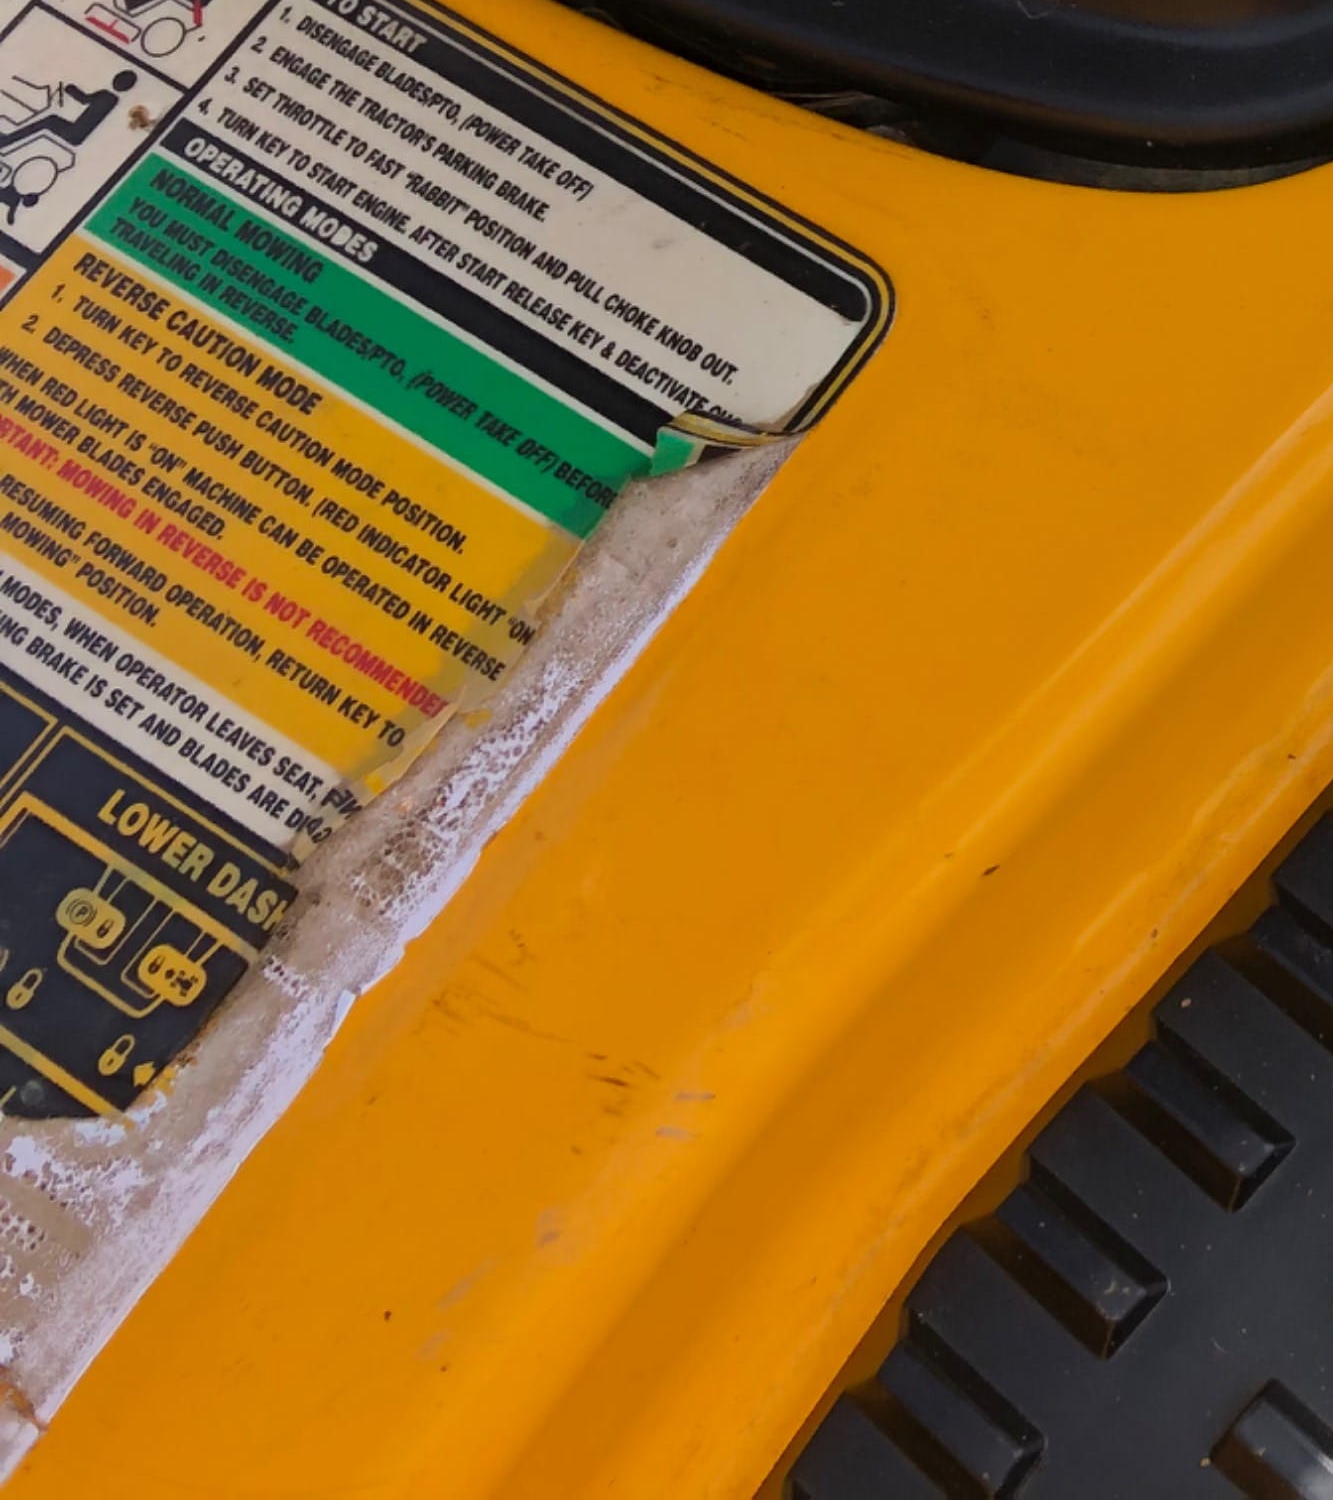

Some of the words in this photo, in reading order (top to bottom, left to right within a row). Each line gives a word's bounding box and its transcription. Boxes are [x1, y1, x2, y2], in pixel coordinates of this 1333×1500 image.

[280, 7, 292, 23] 1.
[296, 16, 379, 71] DISENGAGE
[458, 115, 521, 155] (POWER
[518, 146, 560, 179] TAKE
[556, 171, 594, 201] OFF)
[357, 6, 426, 52] START
[185, 138, 302, 217] OPERATING
[300, 206, 377, 261] MODES
[251, 36, 267, 53] 2.
[270, 46, 331, 89] ENGAGE
[329, 80, 361, 107] THE
[358, 97, 437, 152] TRACTOR'S
[432, 143, 498, 189] PARKING
[495, 180, 549, 222] BRAKE.
[111, 218, 200, 281] TRAVELING
[198, 273, 223, 294] IN
[219, 286, 297, 343] REVERSE.
[150, 169, 235, 231] NORMAL
[235, 220, 323, 283] MOWING
[198, 99, 212, 115] 4.
[218, 107, 260, 140] TURN
[255, 131, 290, 157] KEY
[287, 149, 310, 171] TO
[307, 163, 357, 197] START
[352, 190, 410, 234] ENGINE.
[409, 226, 460, 262] AFTER
[456, 253, 507, 289] START
[502, 281, 572, 331] RELEASE
[568, 321, 604, 349] KEY
[601, 342, 615, 359] &
[615, 350, 709, 416] DEACTIVATE
[224, 67, 240, 84] 3.
[243, 77, 276, 101] SET
[273, 93, 348, 145] THROTTLE
[345, 136, 368, 157] TO
[364, 149, 405, 179] FAST
[464, 209, 536, 260] POSITION
[532, 252, 568, 279] AND
[564, 270, 604, 303] PULL
[604, 294, 659, 335] CHOKE
[655, 326, 702, 361] KNOB
[701, 353, 738, 384] OUT.
[52, 284, 65, 302] 1.
[74, 296, 122, 333] TURN
[118, 325, 158, 354] KEY
[157, 347, 182, 371] TO
[179, 363, 259, 419] REVERSE
[256, 411, 335, 467] CAUTION
[331, 459, 385, 498] MODE
[381, 490, 466, 554] POSITION.
[74, 253, 170, 320] REVERSE
[167, 311, 261, 377] CAUTION
[256, 366, 322, 415] MODE
[130, 198, 168, 228] YOU
[163, 220, 215, 256] MUST
[211, 249, 308, 315] DISENGAGE
[407, 372, 478, 420] (POWER
[476, 411, 521, 446] TAKE
[516, 439, 559, 472] OFF)
[0, 347, 44, 386] WHEN
[40, 377, 78, 407] RED
[74, 399, 129, 438] LIGHT
[124, 430, 147, 451] IS
[183, 467, 262, 524] MACHINE
[259, 516, 299, 548] CAN
[295, 539, 324, 565] BE
[322, 556, 410, 619] OPERATED
[408, 611, 432, 634] IN
[430, 625, 505, 681] REVERSE
[15, 395, 80, 444] MOWER
[77, 436, 145, 485] BLADES
[142, 476, 224, 540] ENGAGED.
[22, 315, 38, 333] 2.
[43, 327, 121, 382] DEPRESS
[118, 373, 197, 430] REVERSE
[192, 420, 244, 459] PUSH
[240, 450, 314, 506] BUTTON.
[312, 498, 359, 532] (RED
[357, 524, 451, 592] INDICATOR
[450, 583, 506, 625] LIGHT
[56, 459, 136, 518] MOWING
[134, 509, 161, 534] IN
[157, 524, 246, 589] REVERSE
[242, 578, 267, 602] IS
[264, 593, 311, 628] NOT
[0, 474, 86, 540] RESUMING
[83, 531, 167, 592] FORWARD
[165, 585, 265, 660] OPERATION,
[266, 649, 341, 705] RETURN
[338, 696, 380, 728] KEY
[378, 721, 405, 747] TO
[76, 562, 159, 627] POSITION.
[0, 576, 62, 630] MODES,
[64, 618, 119, 662] WHEN
[115, 654, 208, 722] OPERATOR
[205, 713, 275, 766] LEAVES
[273, 757, 323, 802] SEAT,
[26, 636, 89, 685] BRAKE
[84, 675, 108, 697] IS
[105, 689, 144, 719] SET
[139, 714, 181, 746] AND
[179, 738, 250, 792] BLADES
[247, 785, 289, 818] ARE
[98, 789, 213, 881] LOWER
